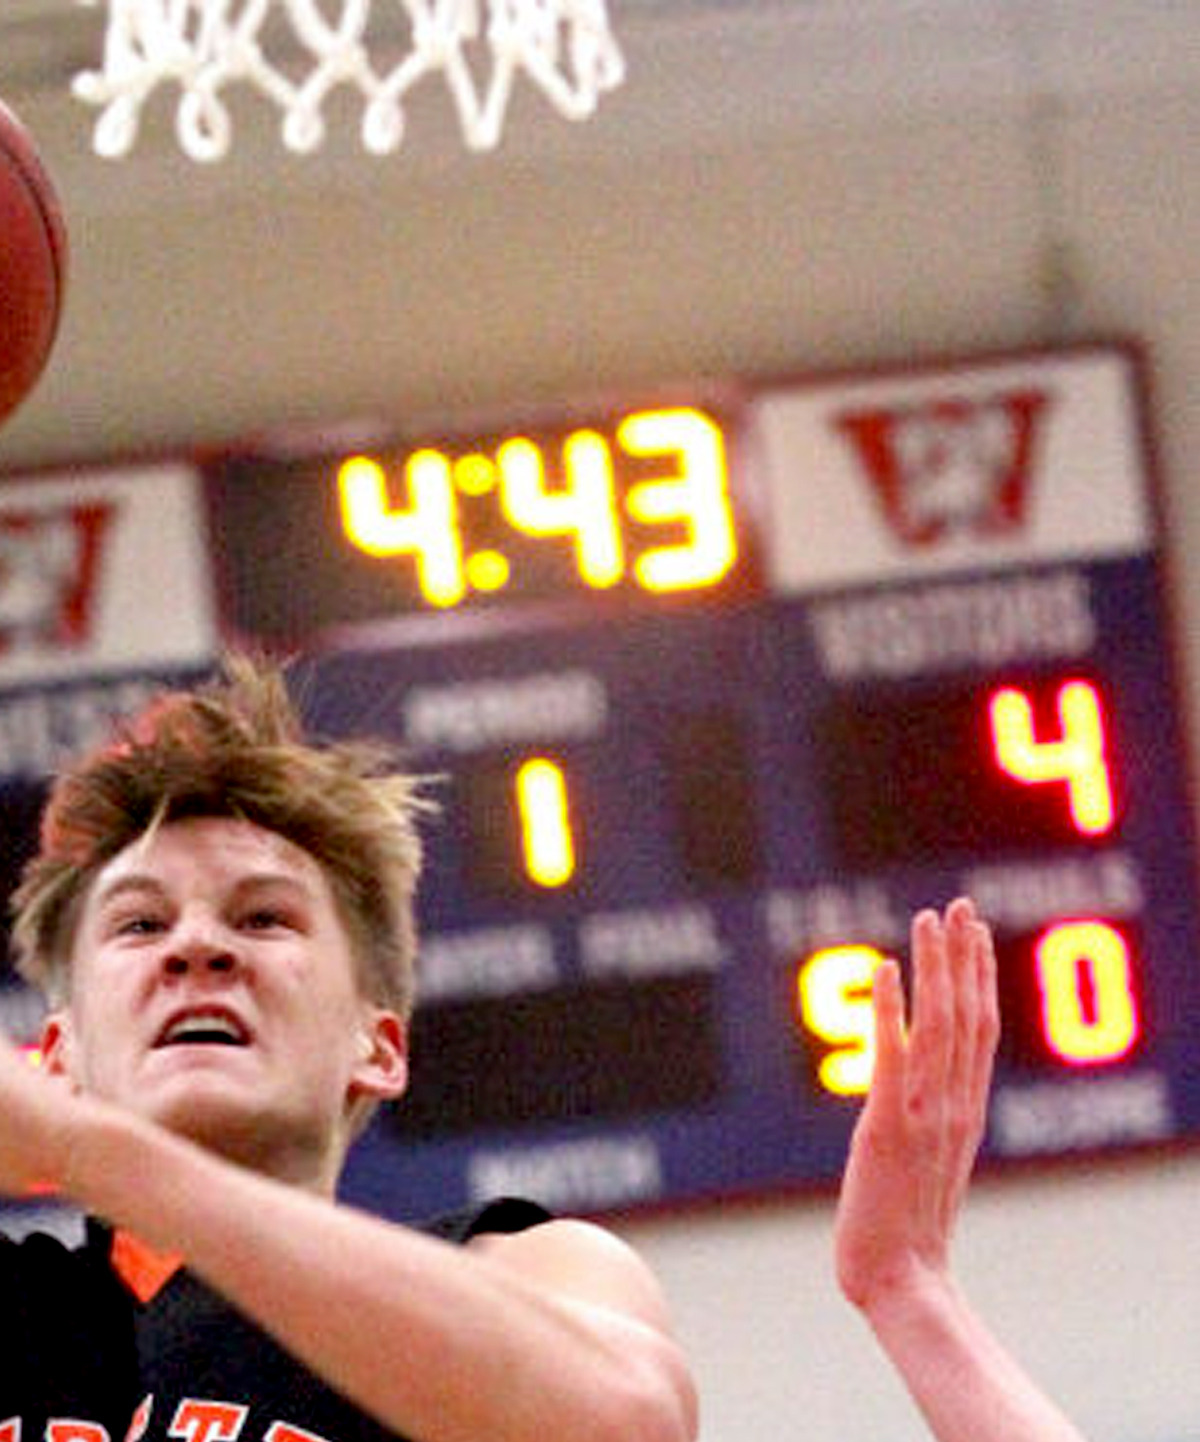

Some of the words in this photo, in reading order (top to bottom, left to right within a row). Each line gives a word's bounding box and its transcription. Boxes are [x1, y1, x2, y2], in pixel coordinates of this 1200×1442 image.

[337, 407, 737, 608] 4:43
[514, 757, 575, 888] 1
[986, 680, 1112, 836] 4
[1035, 918, 1140, 1066] 0
